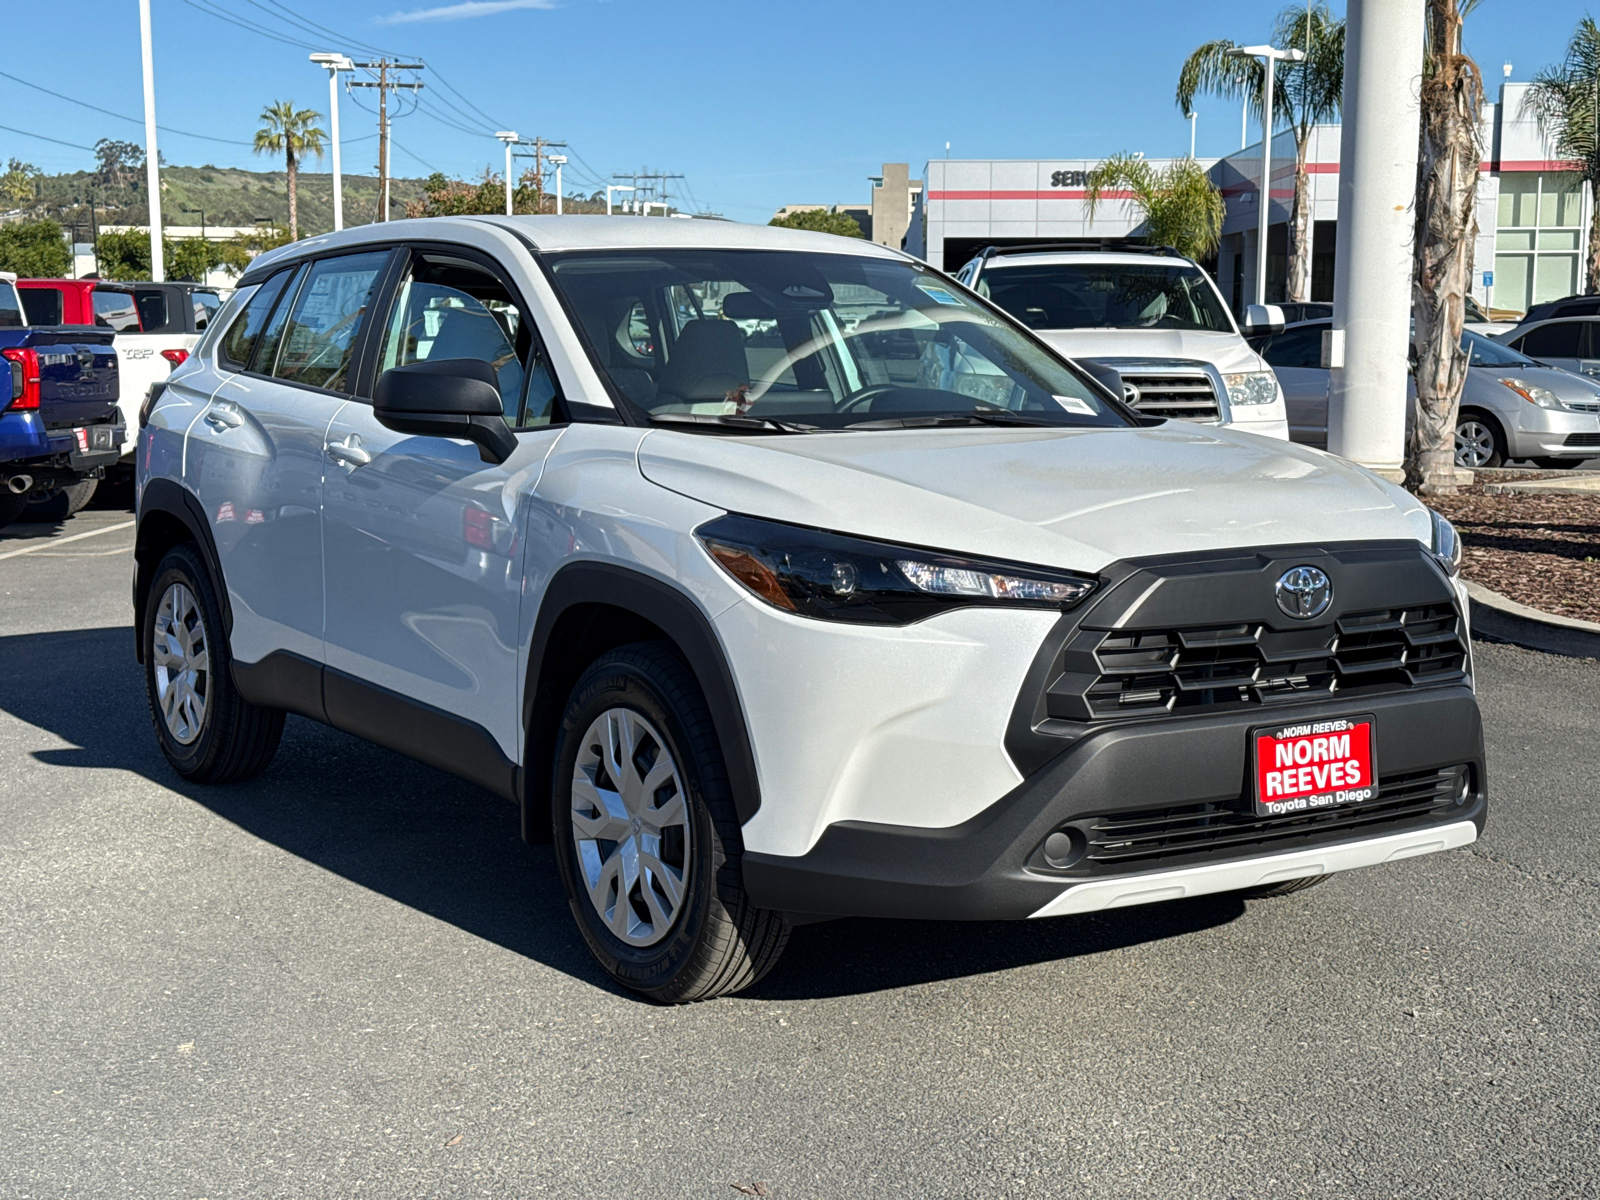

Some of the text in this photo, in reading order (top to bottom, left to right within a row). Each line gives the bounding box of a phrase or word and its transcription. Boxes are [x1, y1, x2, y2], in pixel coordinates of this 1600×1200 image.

[579, 676, 627, 706] MICHELIN
[1283, 720, 1347, 738] NORM REEVES
[1275, 734, 1351, 768] NORM
[1266, 759, 1361, 797] REEVES
[1266, 789, 1372, 814] Toyota San Diego
[617, 955, 671, 980] MICHELIN
